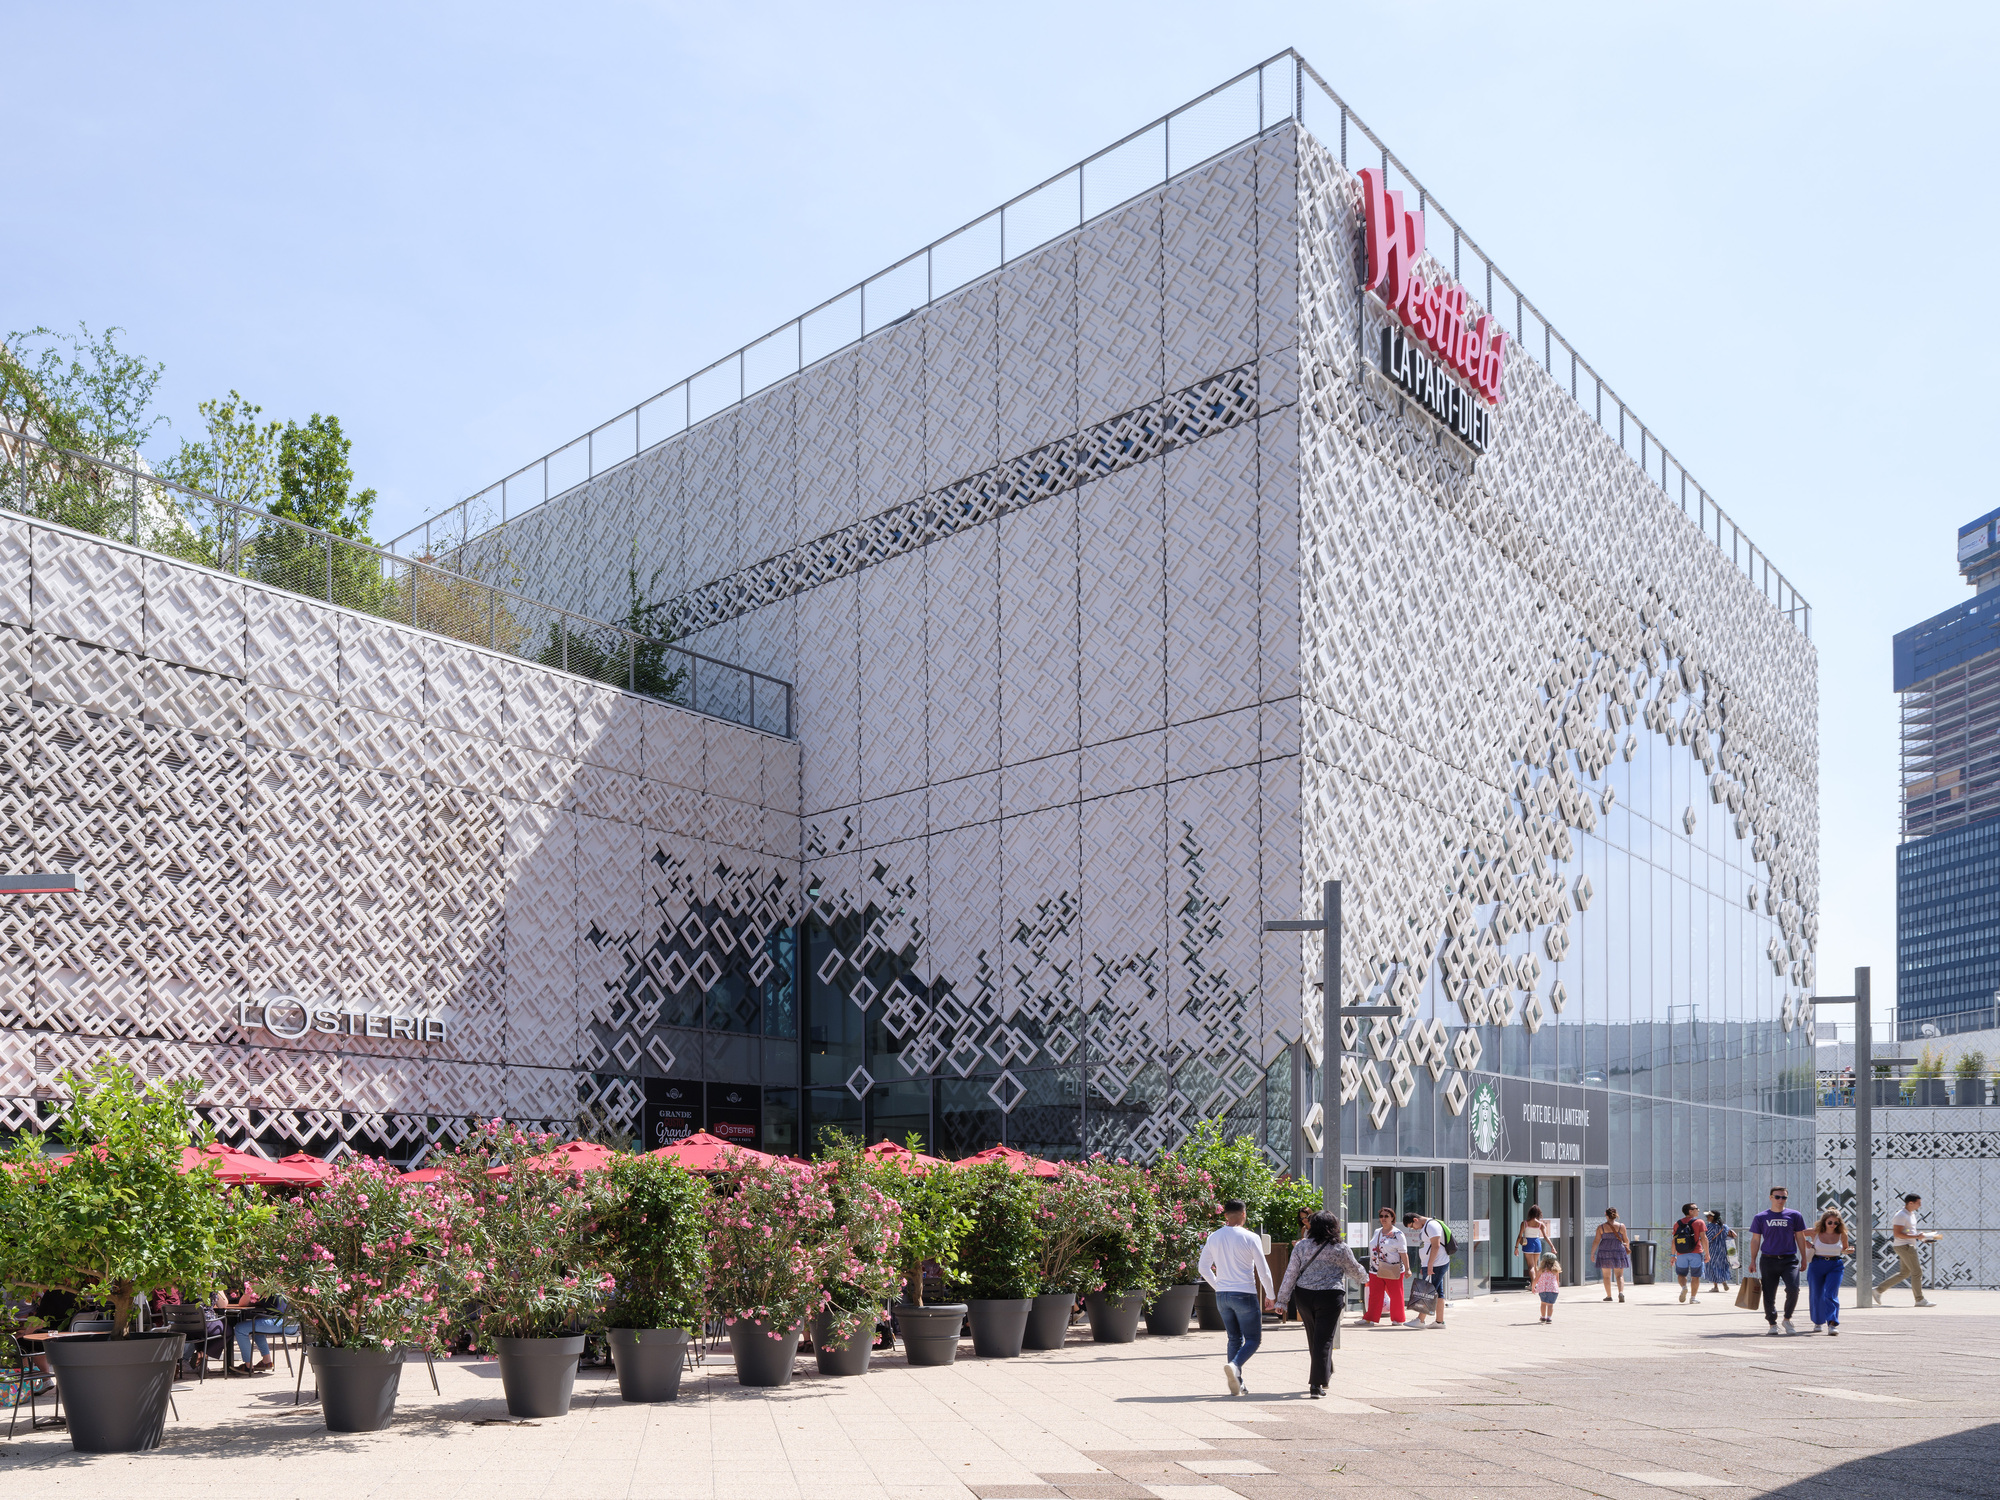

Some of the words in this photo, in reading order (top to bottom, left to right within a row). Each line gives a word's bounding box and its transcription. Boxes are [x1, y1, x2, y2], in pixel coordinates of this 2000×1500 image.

[1357, 167, 1509, 404] Westfield
[1389, 325, 1412, 389] LA
[1415, 347, 1490, 454] PART-DIEU
[238, 995, 448, 1043] L'OSTERIA
[659, 1110, 692, 1118] GRANDE
[1523, 1104, 1543, 1123] PORTE
[1544, 1105, 1552, 1124] DE
[1552, 1106, 1560, 1125] LA
[1561, 1107, 1590, 1127] LANTERNE
[656, 1122, 692, 1144] Grande
[716, 1124, 754, 1136] L'OSTERIA
[1540, 1142, 1556, 1160] TOUR
[1558, 1142, 1580, 1160] CRAYON
[1766, 1219, 1788, 1227] VANS
